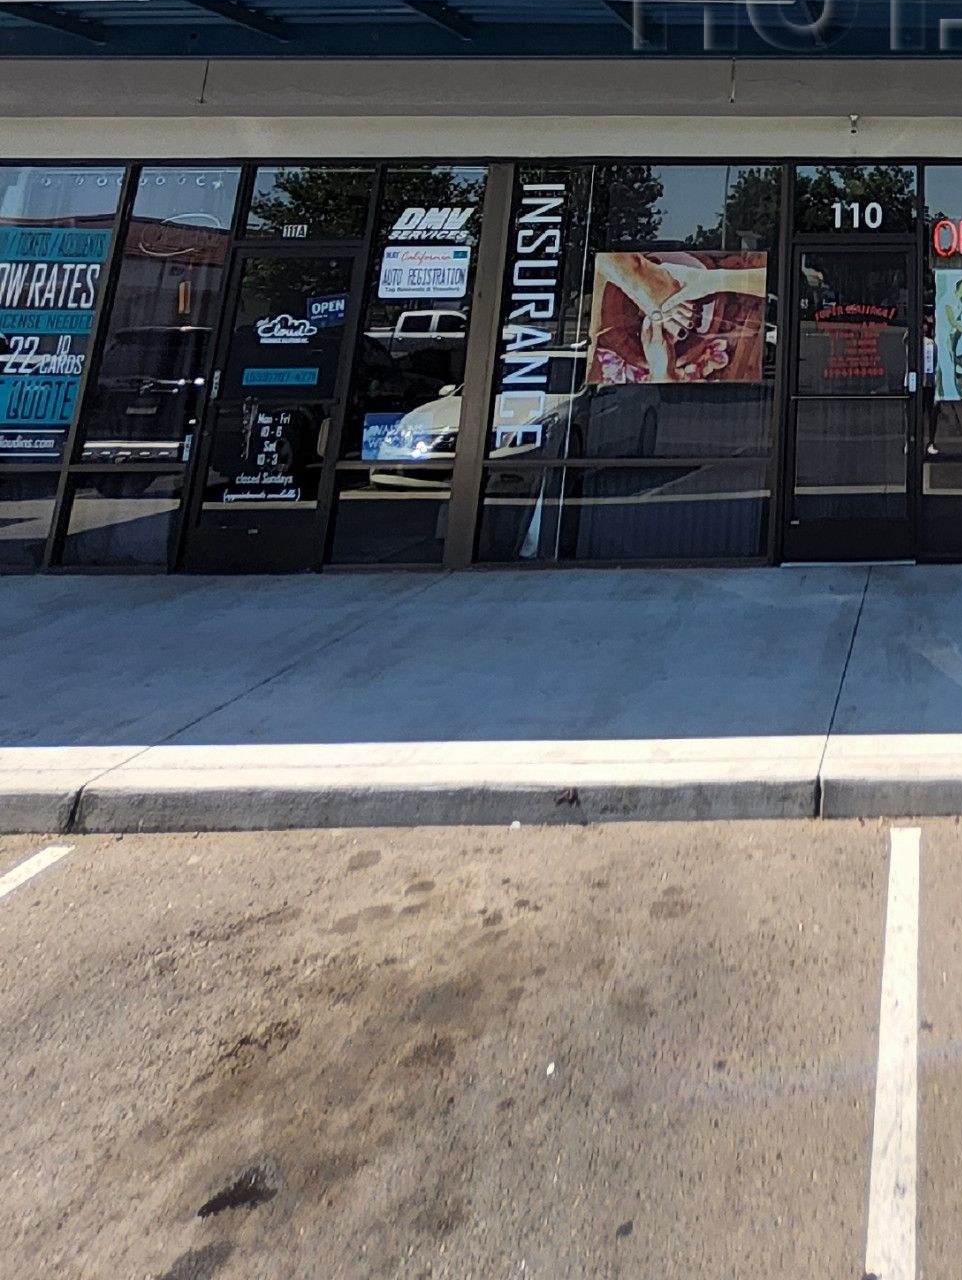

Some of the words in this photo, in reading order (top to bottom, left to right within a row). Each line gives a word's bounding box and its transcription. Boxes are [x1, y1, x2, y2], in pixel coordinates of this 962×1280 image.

[392, 207, 475, 230] DMV
[831, 201, 883, 229] 110
[388, 230, 470, 240] SERVICES
[401, 250, 453, 266] California
[26, 263, 101, 309] RATES
[382, 267, 404, 287] AUTO
[407, 267, 467, 287] REGISTRATION
[311, 299, 345, 316] OPEN
[495, 183, 566, 449] INSURANCE
[258, 318, 318, 338] Cloud
[3, 336, 40, 374] 22
[57, 334, 72, 356] ID
[39, 354, 85, 375] CARDS
[5, 380, 77, 420] QUOTE
[257, 413, 273, 424] Mon
[280, 412, 291, 424] Fri
[260, 426, 270, 437] 10
[263, 440, 277, 452] Sat
[257, 453, 266, 465] 10
[271, 453, 278, 465] 3
[261, 472, 294, 487] Sundays
